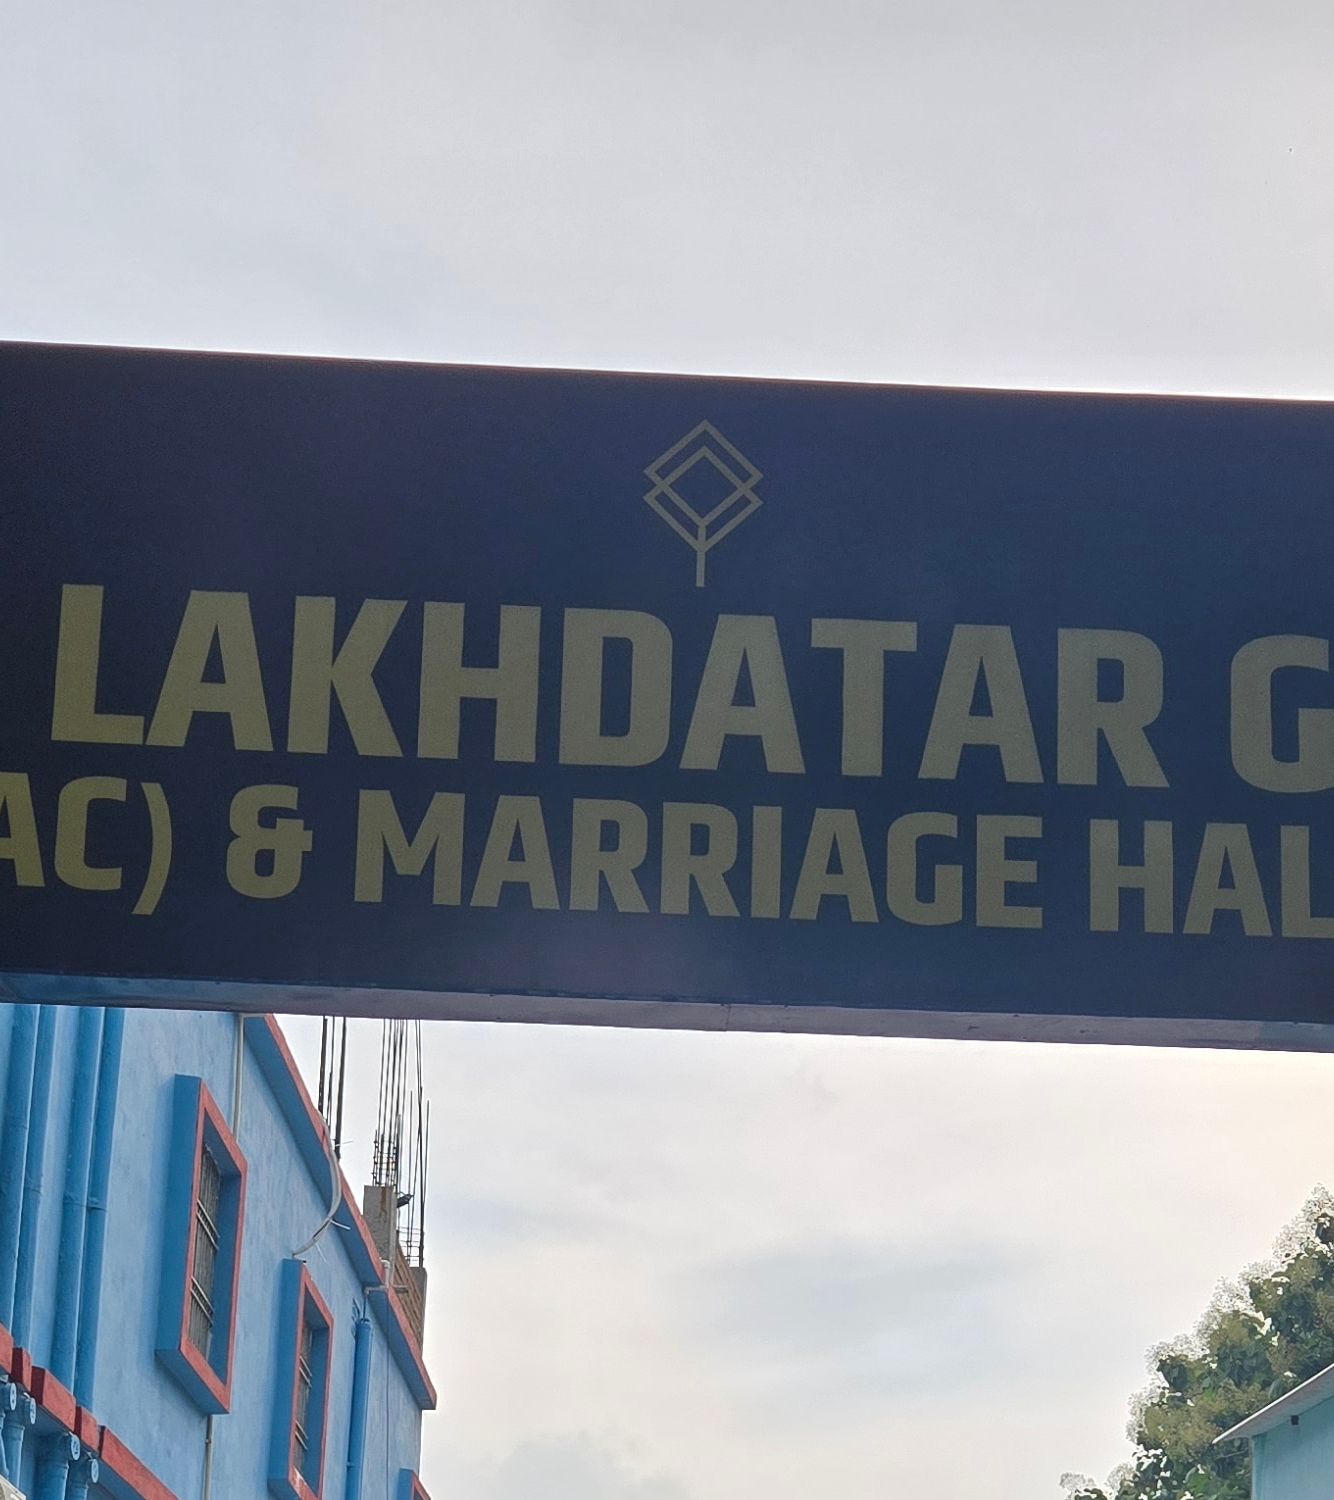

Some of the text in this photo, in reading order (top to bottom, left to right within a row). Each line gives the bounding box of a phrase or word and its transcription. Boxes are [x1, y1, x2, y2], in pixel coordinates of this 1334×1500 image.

[51, 582, 1169, 790] LAKHDATAR
[225, 783, 314, 903] &
[352, 788, 1045, 930] MARRIAGE
